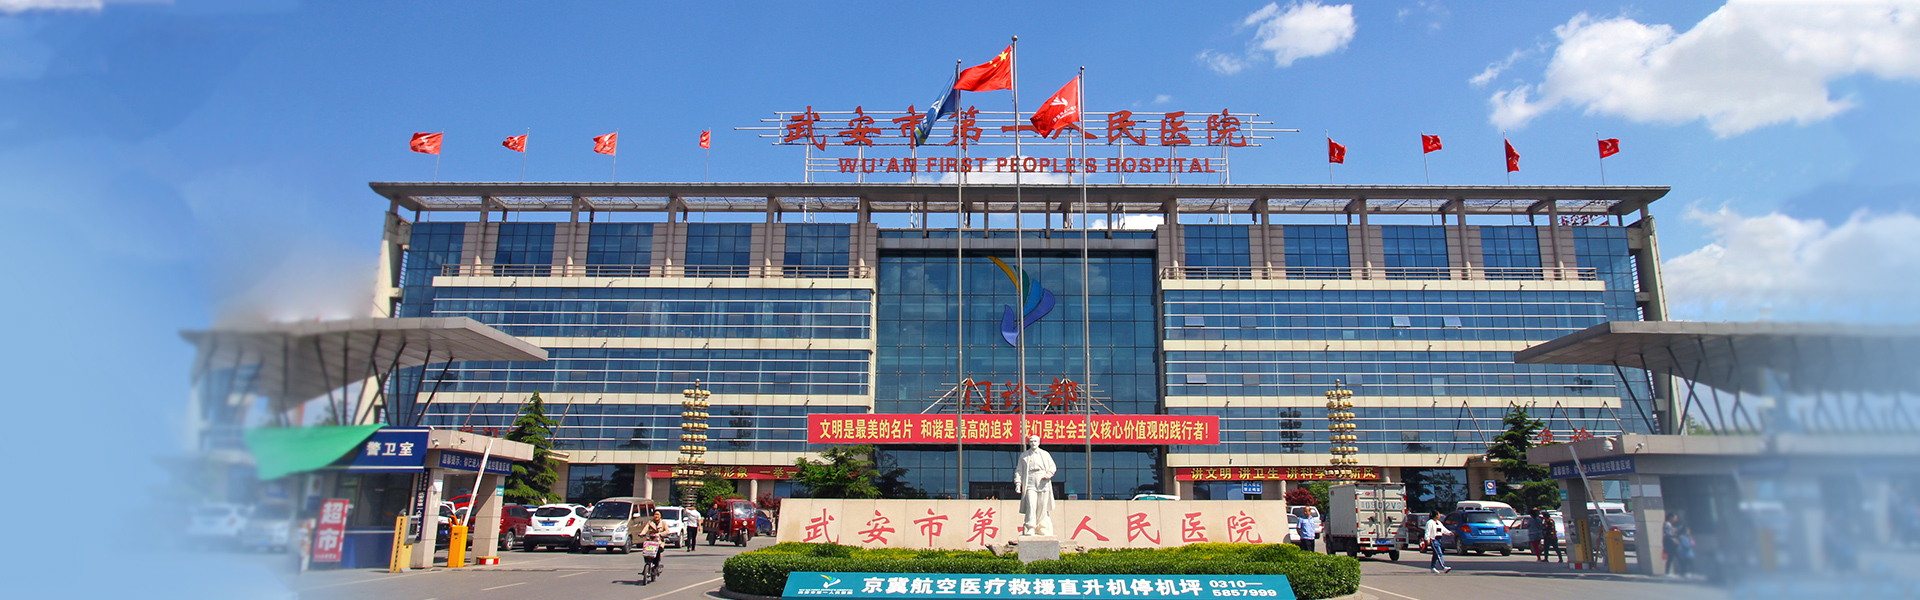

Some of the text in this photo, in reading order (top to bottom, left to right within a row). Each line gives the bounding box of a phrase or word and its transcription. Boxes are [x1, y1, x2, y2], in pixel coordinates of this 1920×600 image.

[838, 157, 1216, 173] WU'AN FIRST PEOPLE'S HOSPITAL
[965, 376, 1079, 414] 门诊部
[819, 418, 914, 440] 文明是最美的名片
[920, 418, 1014, 440] 和谐是最高的追求
[366, 441, 415, 457] 警卫室
[1190, 467, 1232, 480] 讲文明
[1238, 467, 1280, 480] 讲卫生
[1286, 467, 1326, 480] 讲科学
[319, 501, 344, 551] 超市
[802, 506, 1264, 547] 武安市第人民医院
[861, 576, 1204, 597] 京冀航空医疗救援直升机停机坪
[1212, 589, 1278, 597] 5857999
